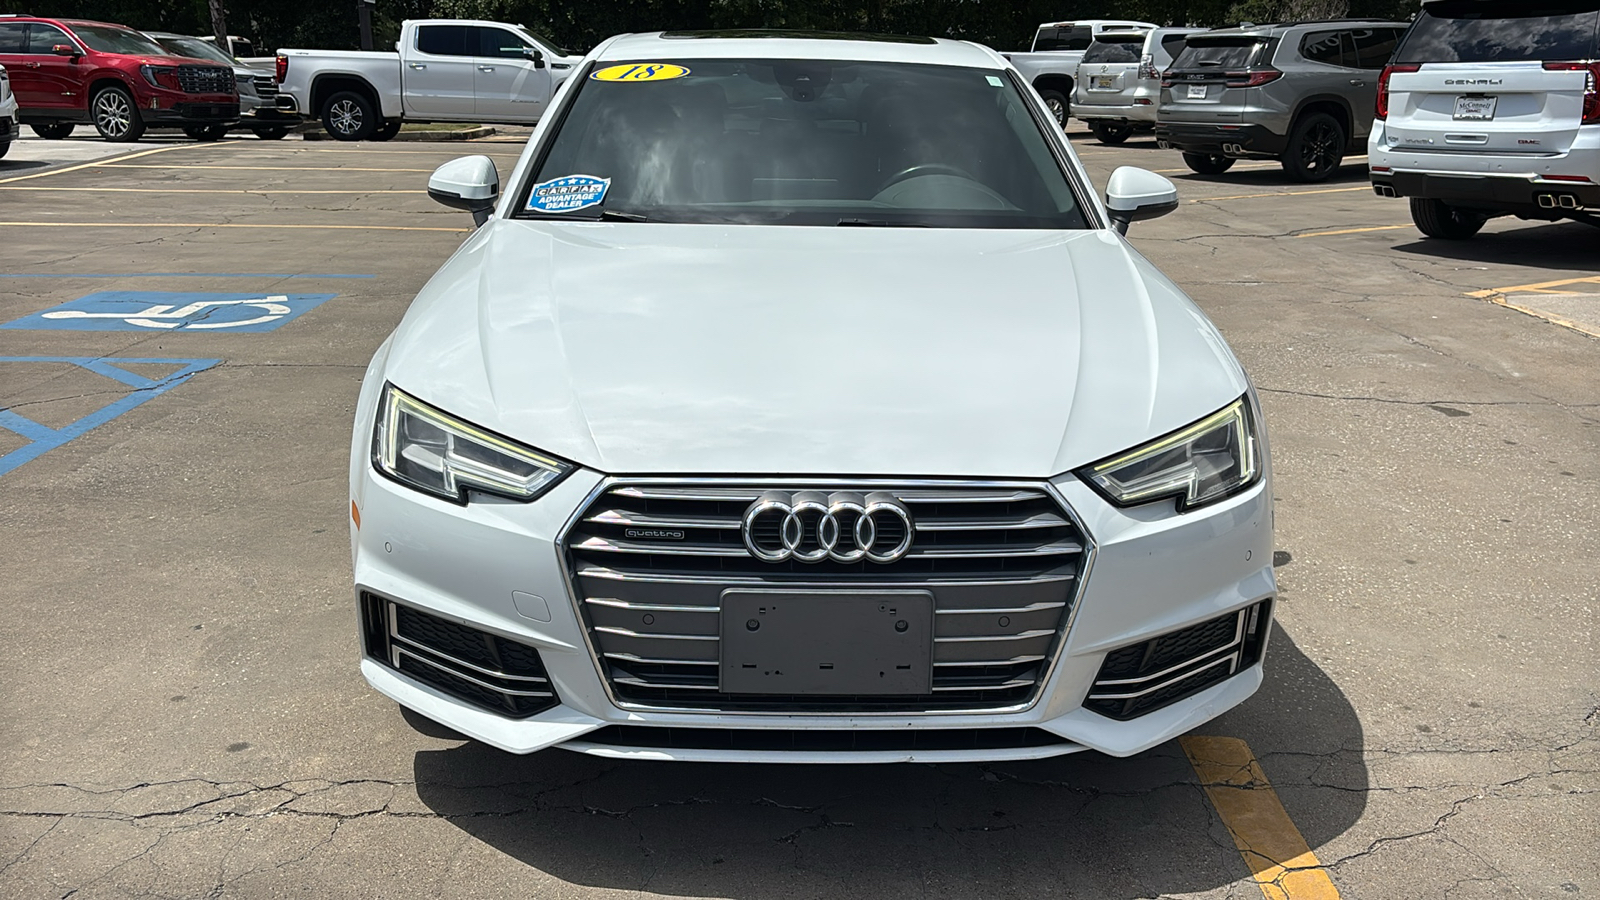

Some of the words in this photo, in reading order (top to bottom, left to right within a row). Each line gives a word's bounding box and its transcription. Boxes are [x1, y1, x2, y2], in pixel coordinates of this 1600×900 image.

[613, 64, 665, 79] 18
[1459, 101, 1491, 110] McConnell
[537, 184, 603, 197] CARFAX
[538, 193, 596, 204] ADVANTAGE
[545, 200, 583, 210] DEALER
